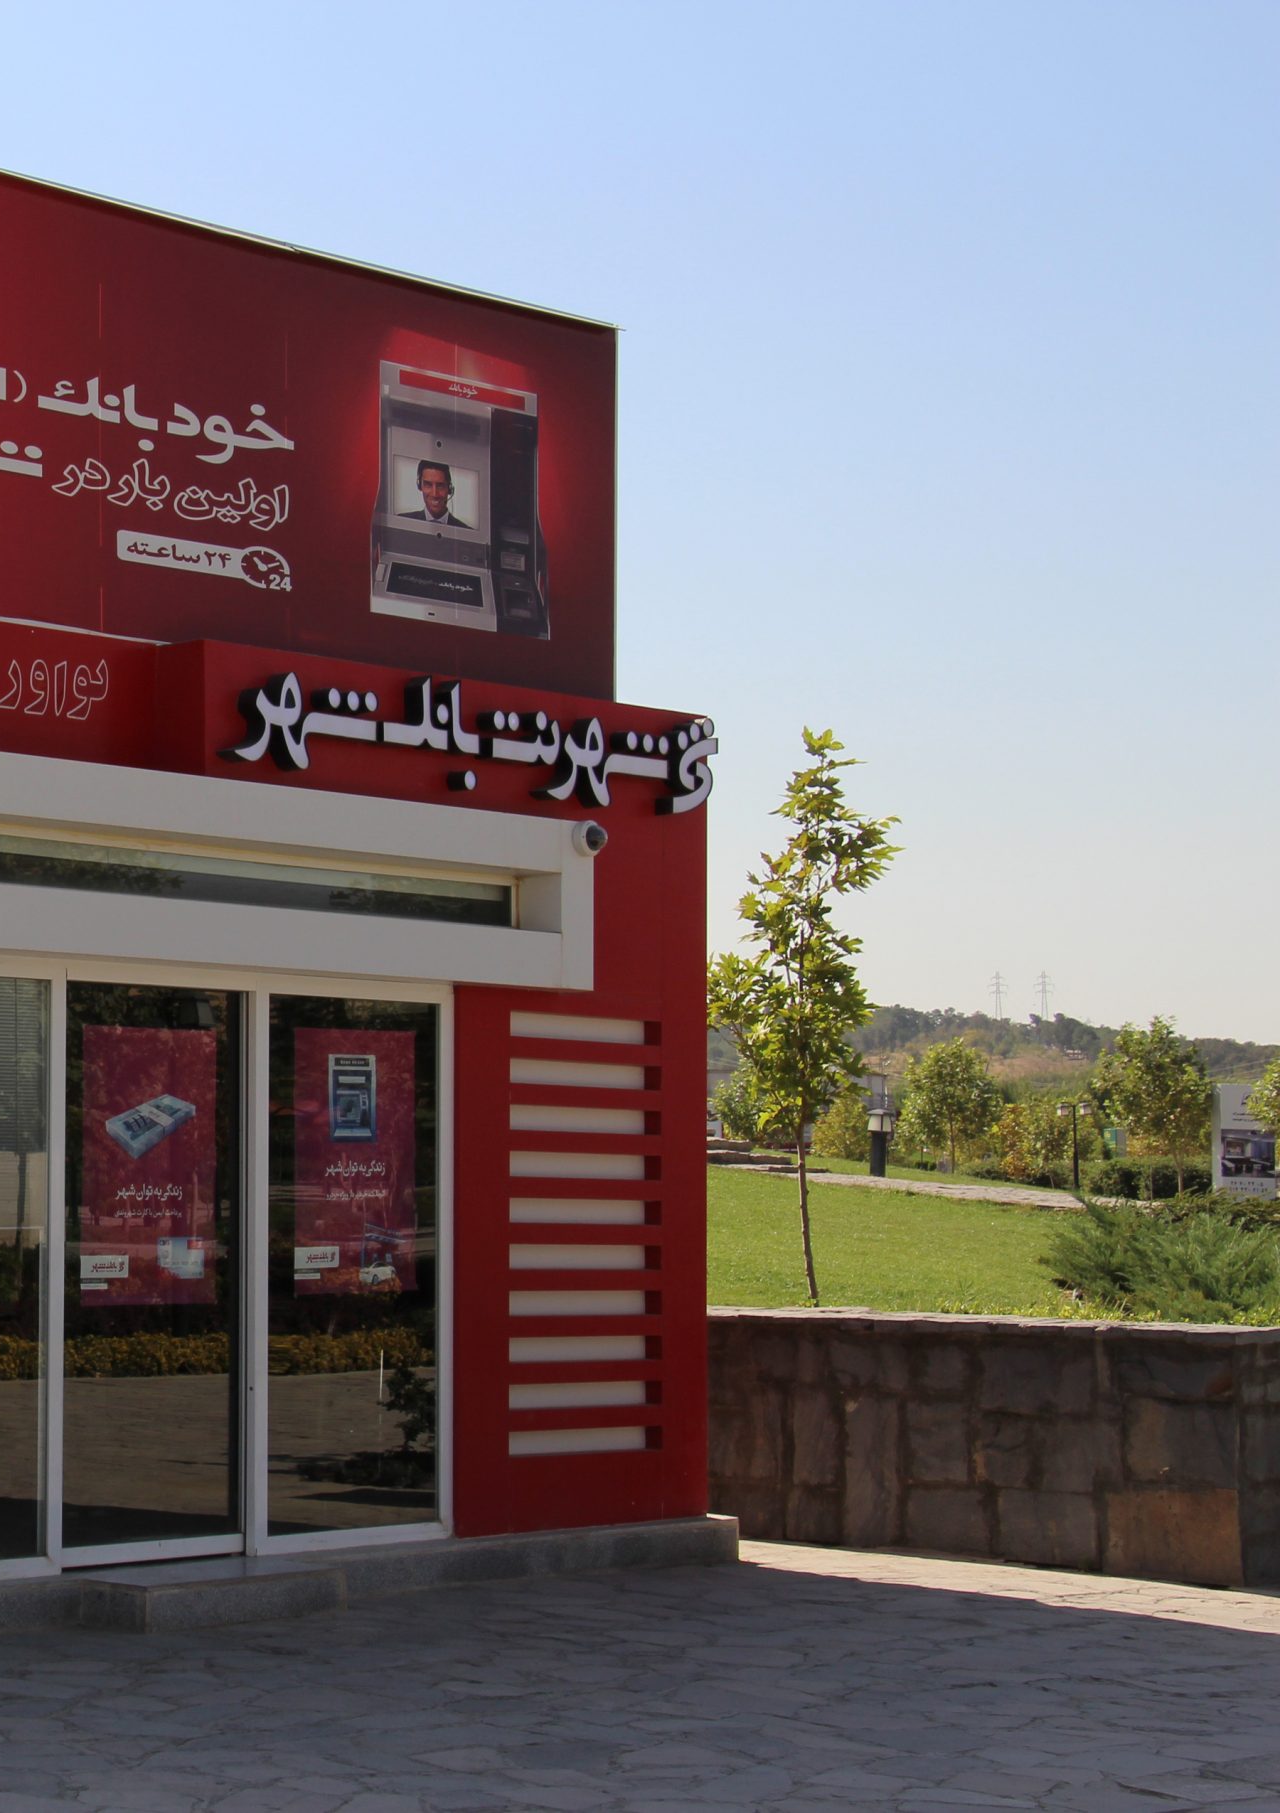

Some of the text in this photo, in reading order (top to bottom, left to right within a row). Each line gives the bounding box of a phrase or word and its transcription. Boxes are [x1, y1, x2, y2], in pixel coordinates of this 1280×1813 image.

[52, 458, 111, 496] در
[107, 459, 170, 511] بار
[174, 477, 289, 531] اولین
[126, 540, 201, 566] ساعته
[269, 575, 293, 592] 24
[222, 671, 378, 770] شهر
[382, 676, 480, 791] بانک
[324, 1160, 342, 1177] شهر
[114, 1183, 135, 1201] شهر
[160, 1183, 183, 1201] زندگی
